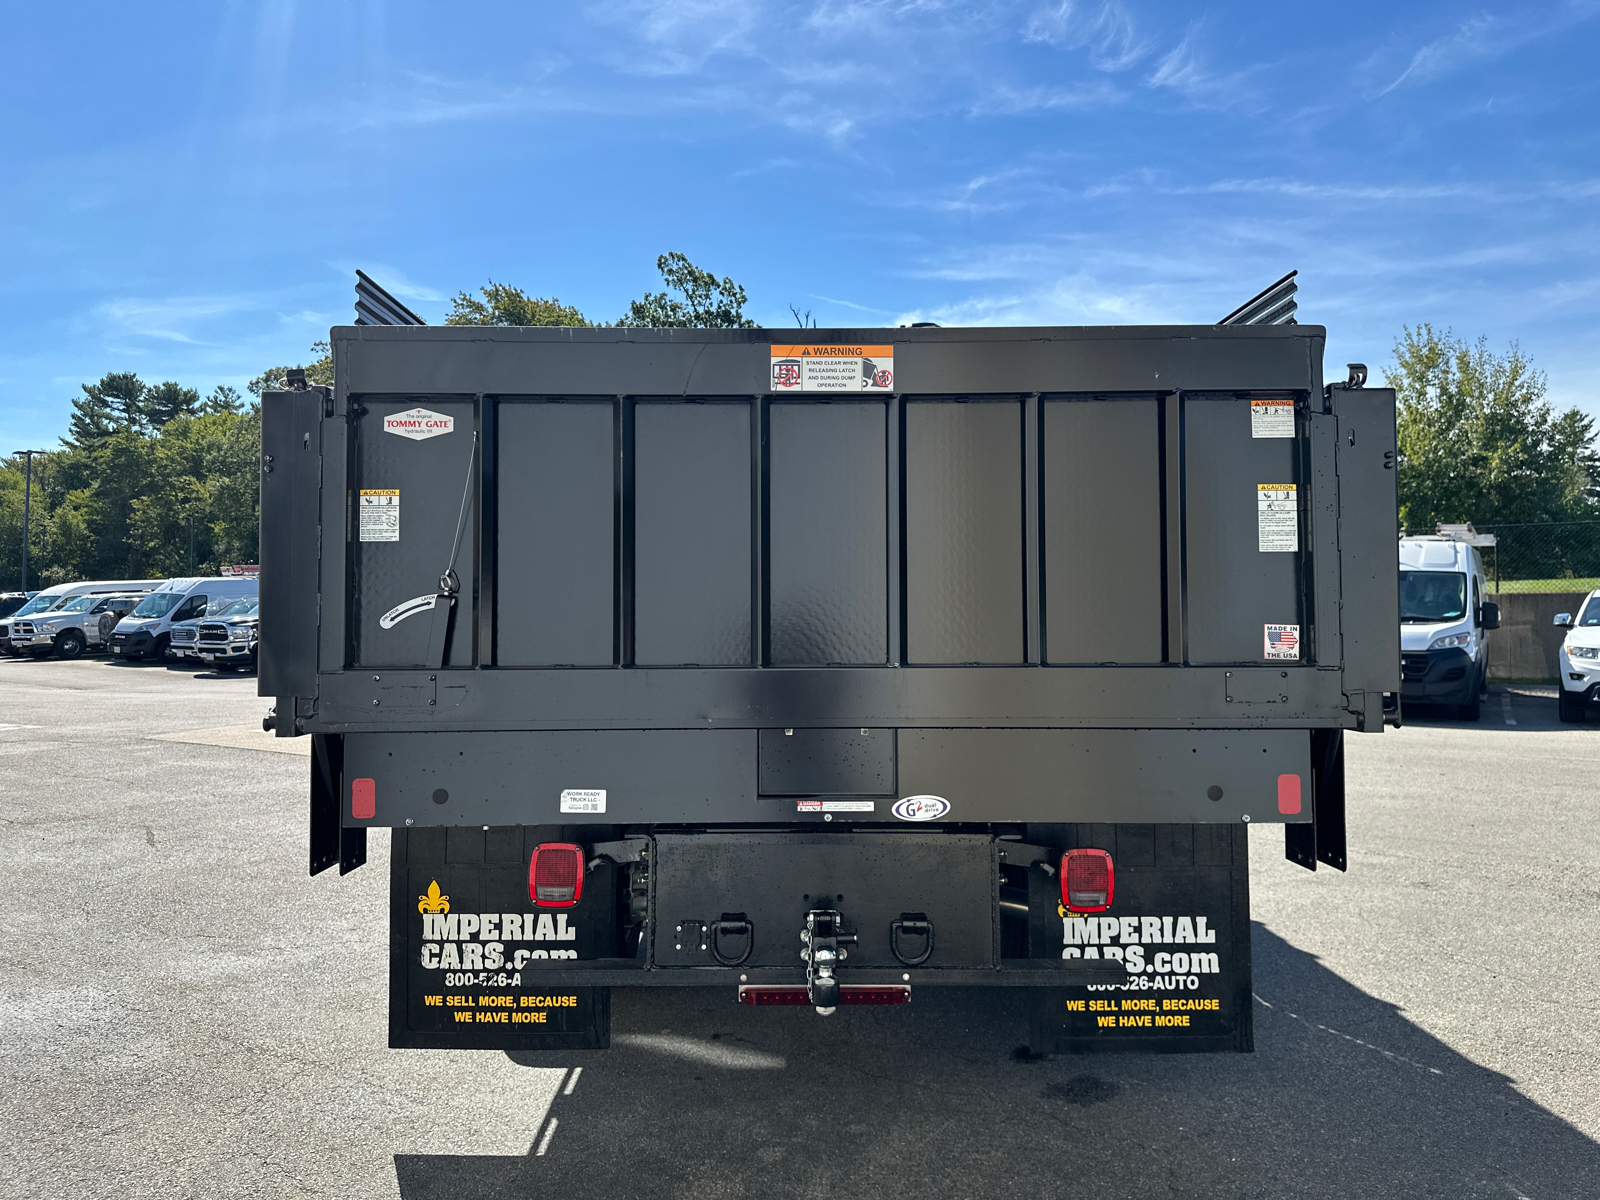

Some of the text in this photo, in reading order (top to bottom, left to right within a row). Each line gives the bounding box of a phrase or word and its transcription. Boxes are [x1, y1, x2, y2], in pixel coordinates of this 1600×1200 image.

[814, 347, 863, 356] WARNING
[382, 608, 399, 622] UNLATCH
[422, 913, 576, 941] IMPERIAL
[1062, 916, 1216, 945] IMPERIAL
[445, 973, 521, 987] 800-526-A
[424, 996, 577, 1009] WE SELL MORE, BECAUSE
[1066, 999, 1220, 1012] WE SELL MORE, BECAUSE
[454, 1012, 547, 1023] WE HAVE MORE
[1097, 1015, 1190, 1027] WE HAVE MORE
